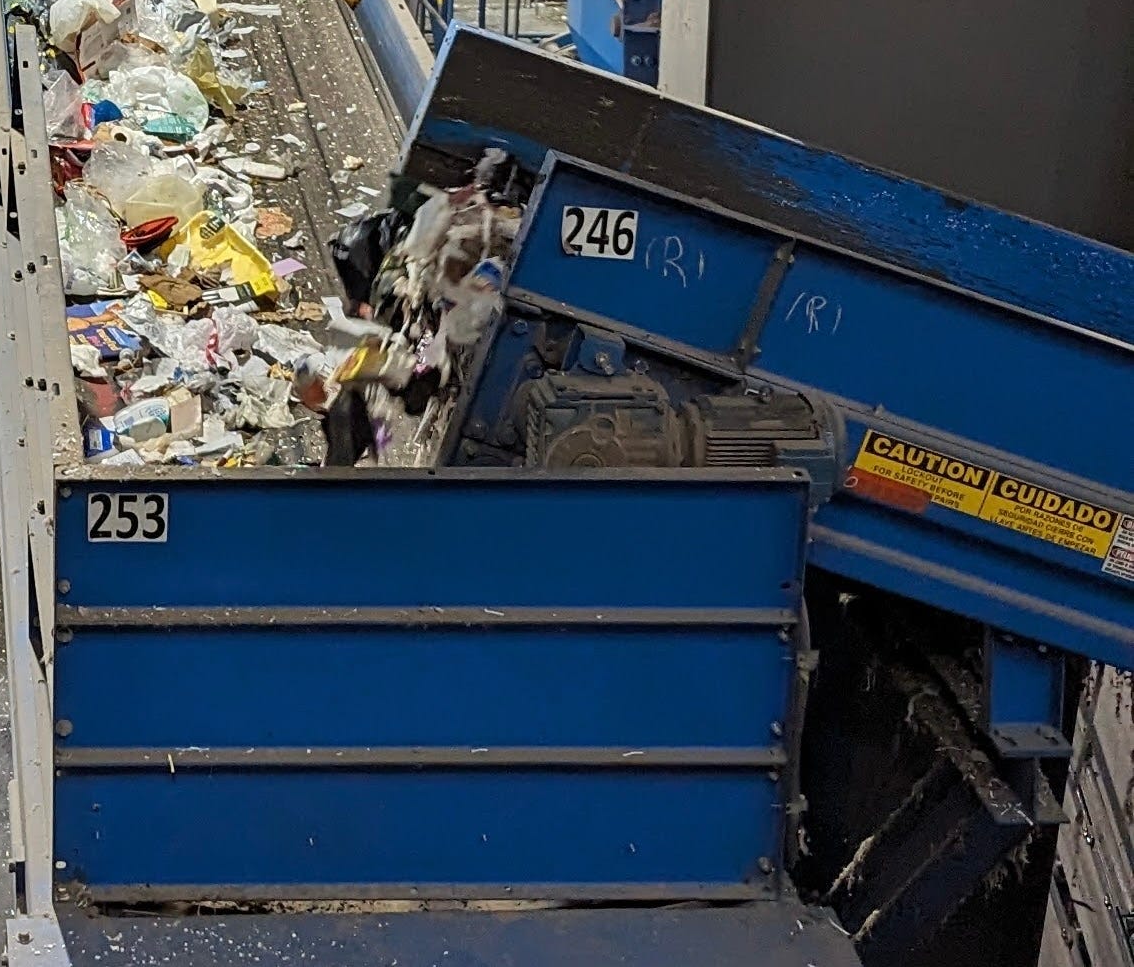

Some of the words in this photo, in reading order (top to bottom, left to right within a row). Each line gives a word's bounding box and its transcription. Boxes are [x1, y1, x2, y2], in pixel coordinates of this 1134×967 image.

[565, 207, 635, 255] 246
[872, 436, 984, 486] CAUTION
[873, 465, 892, 477] FOR
[894, 472, 928, 488] SAFETY
[929, 483, 966, 501] BEFORE
[901, 465, 944, 484] LOCKOUT
[89, 493, 166, 539] 253
[1000, 479, 1113, 530] CUIDADO
[1014, 504, 1032, 516] POR
